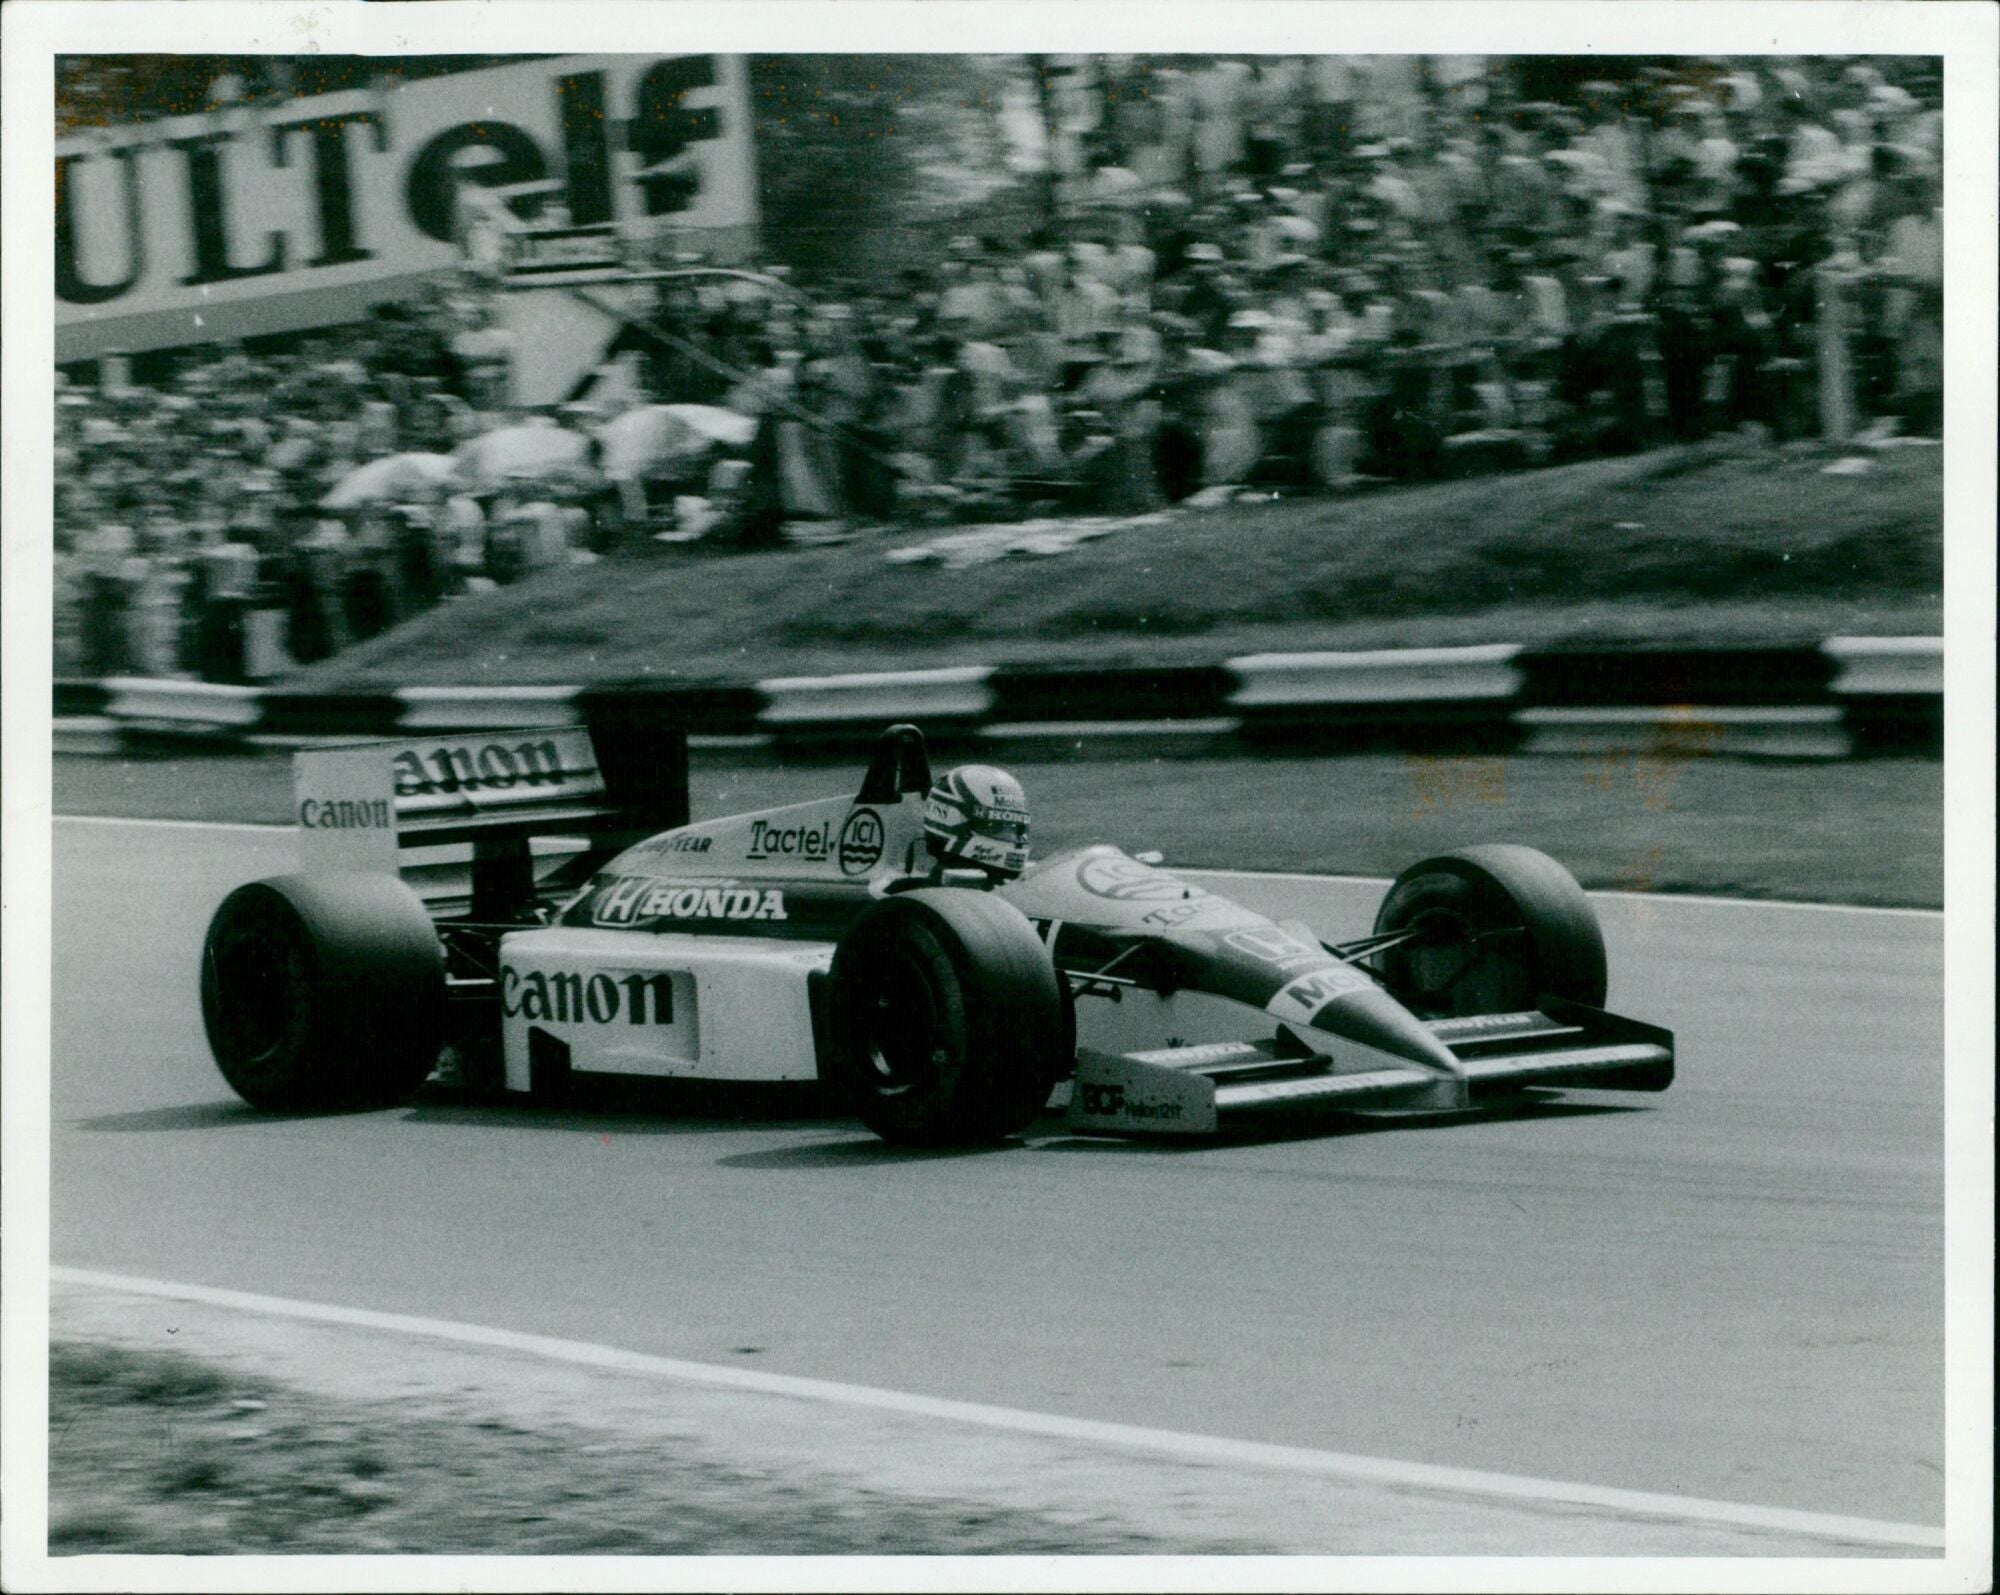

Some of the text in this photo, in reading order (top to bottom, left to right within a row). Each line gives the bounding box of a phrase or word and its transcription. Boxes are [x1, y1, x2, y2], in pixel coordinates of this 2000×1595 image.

[396, 739, 567, 796] anon
[301, 797, 389, 829] Canon
[747, 820, 830, 860] Tactel
[851, 821, 876, 845] ICI
[641, 889, 788, 920] HONDA
[502, 964, 674, 1025] Canon
